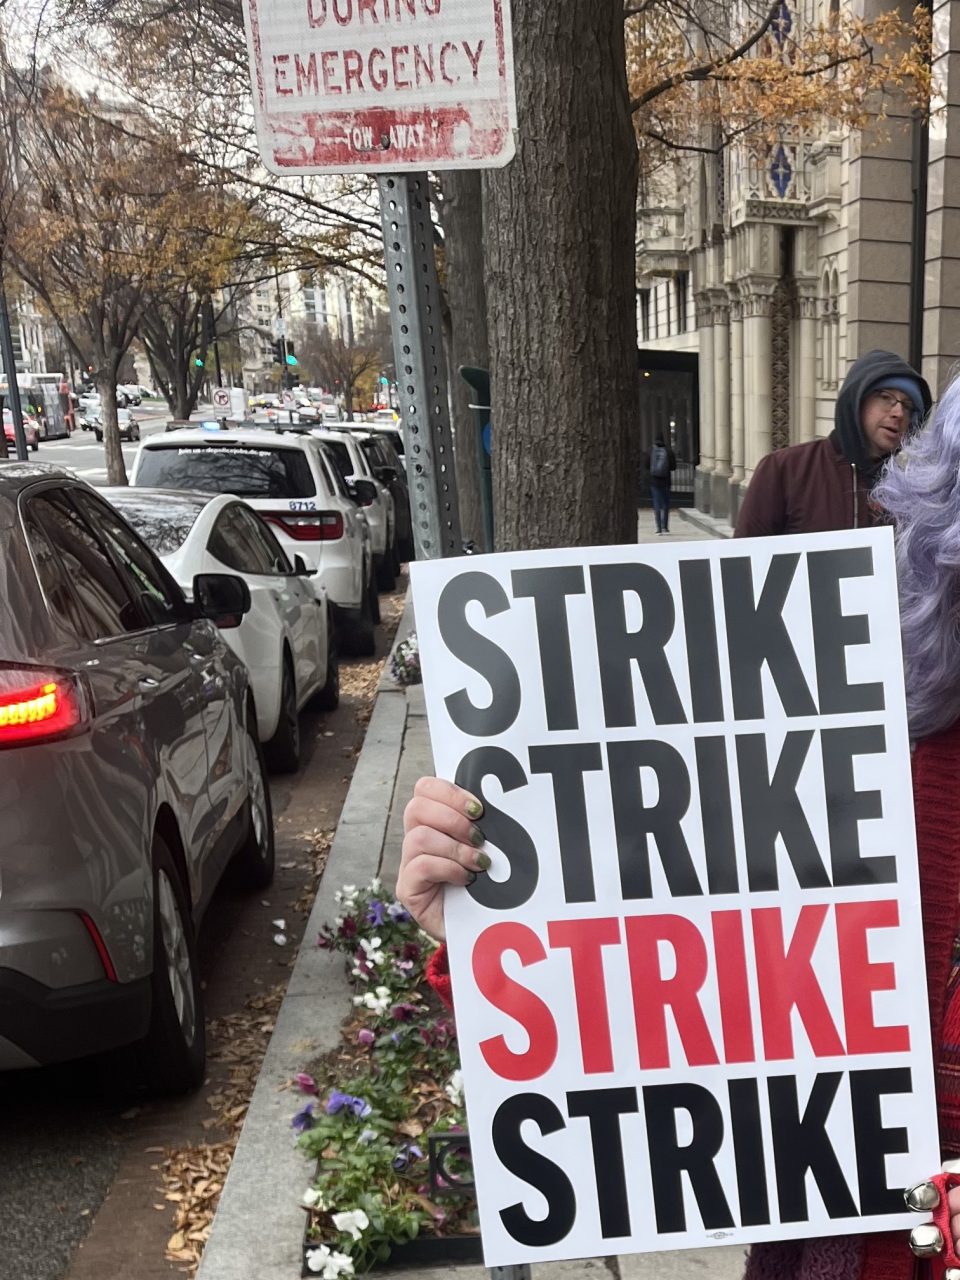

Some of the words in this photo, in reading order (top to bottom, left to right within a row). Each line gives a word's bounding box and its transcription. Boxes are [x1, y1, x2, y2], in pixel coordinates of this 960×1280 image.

[272, 40, 485, 97] EMERGENCY
[389, 123, 425, 149] AWAY
[437, 547, 885, 737] STRIKE
[454, 725, 897, 910] STRIKE
[472, 900, 910, 1081] STRIKE
[491, 1067, 919, 1247] STRIKE
